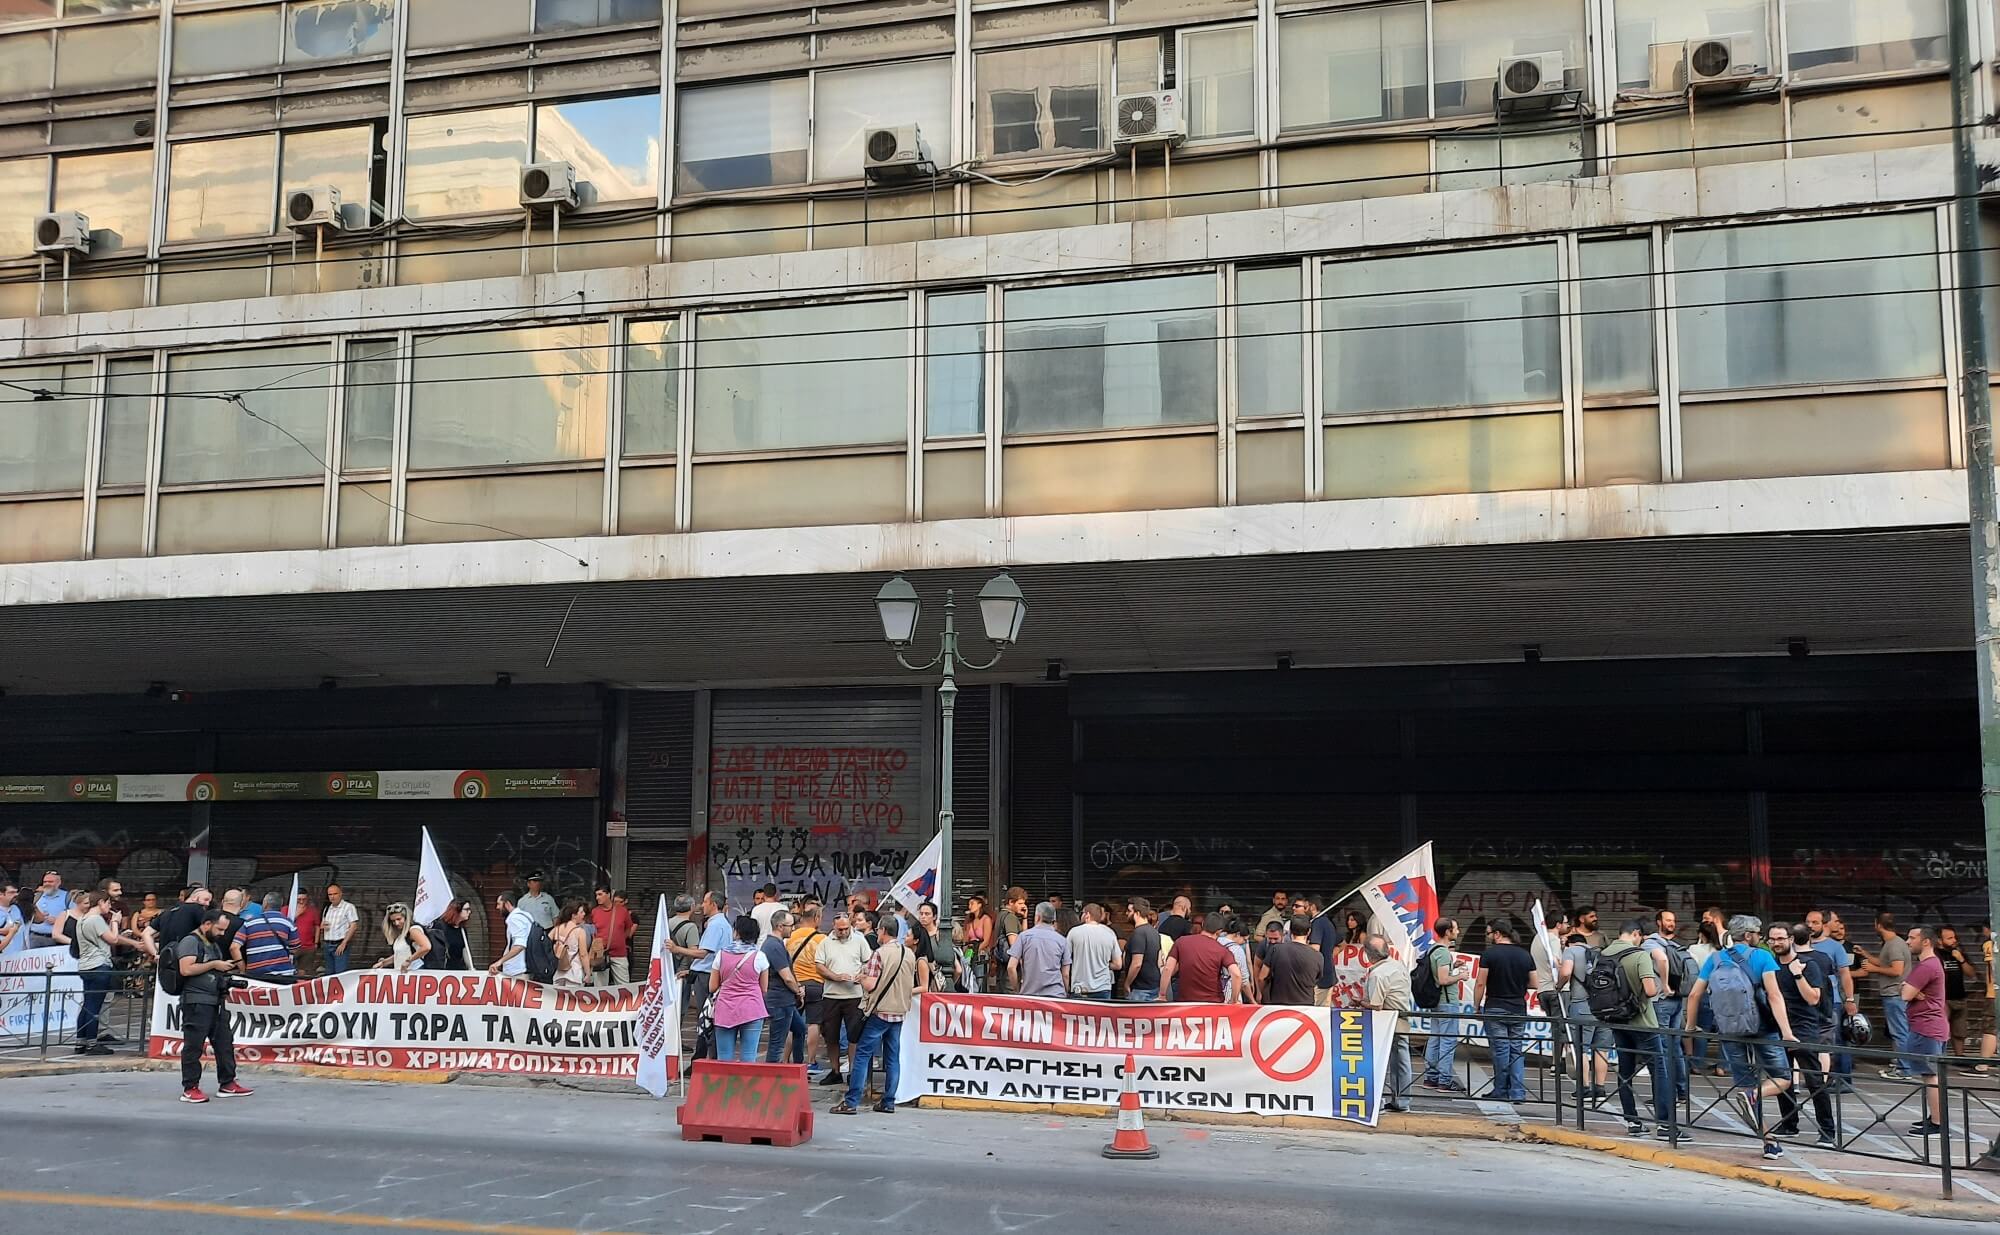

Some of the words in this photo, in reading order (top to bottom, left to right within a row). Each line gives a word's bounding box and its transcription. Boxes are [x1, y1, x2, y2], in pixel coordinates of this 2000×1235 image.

[87, 783, 112, 792] ΙΡΙΔΑ
[346, 779, 373, 789] ΙΡΙΔΑ
[827, 771, 868, 799] ΔΕΝ
[771, 802, 797, 826] ΜΕ
[809, 801, 843, 825] 400
[727, 854, 782, 876] ΔΕΝ
[790, 852, 825, 878] ΘΑ
[291, 976, 345, 1006] ΠΙΑ
[356, 974, 544, 1009] ΠΛΗΡΩΣΑΜΕ
[230, 1011, 378, 1041] ΛΗΡΩΣΟΥΝ
[390, 1012, 469, 1042] ΤΩΡΑ
[481, 1014, 515, 1044] ΤΑ
[928, 1001, 973, 1039] ΟΧΙ
[981, 1005, 1053, 1044] ΣΤΗΝ
[1061, 1013, 1234, 1052] ΤΗΛΕΡΓΑΣΙΑ
[273, 1046, 393, 1068] ΣΩΜΑΤΕΙΟ
[405, 1050, 637, 1075] ΧΡΗΜΑΤΟΠΙΣΤΩΤΙΚ
[928, 1053, 1102, 1079] ΚΑΤΑΡΓΗΣΗ
[1339, 1011, 1366, 1119] ΣΕΤΗΠ
[927, 1078, 989, 1096] ΤΩΝ
[999, 1082, 1233, 1108] ΑΝΤΕΡΓΤΙΚΩΝ
[1245, 1093, 1314, 1112] ΠΝΠ
